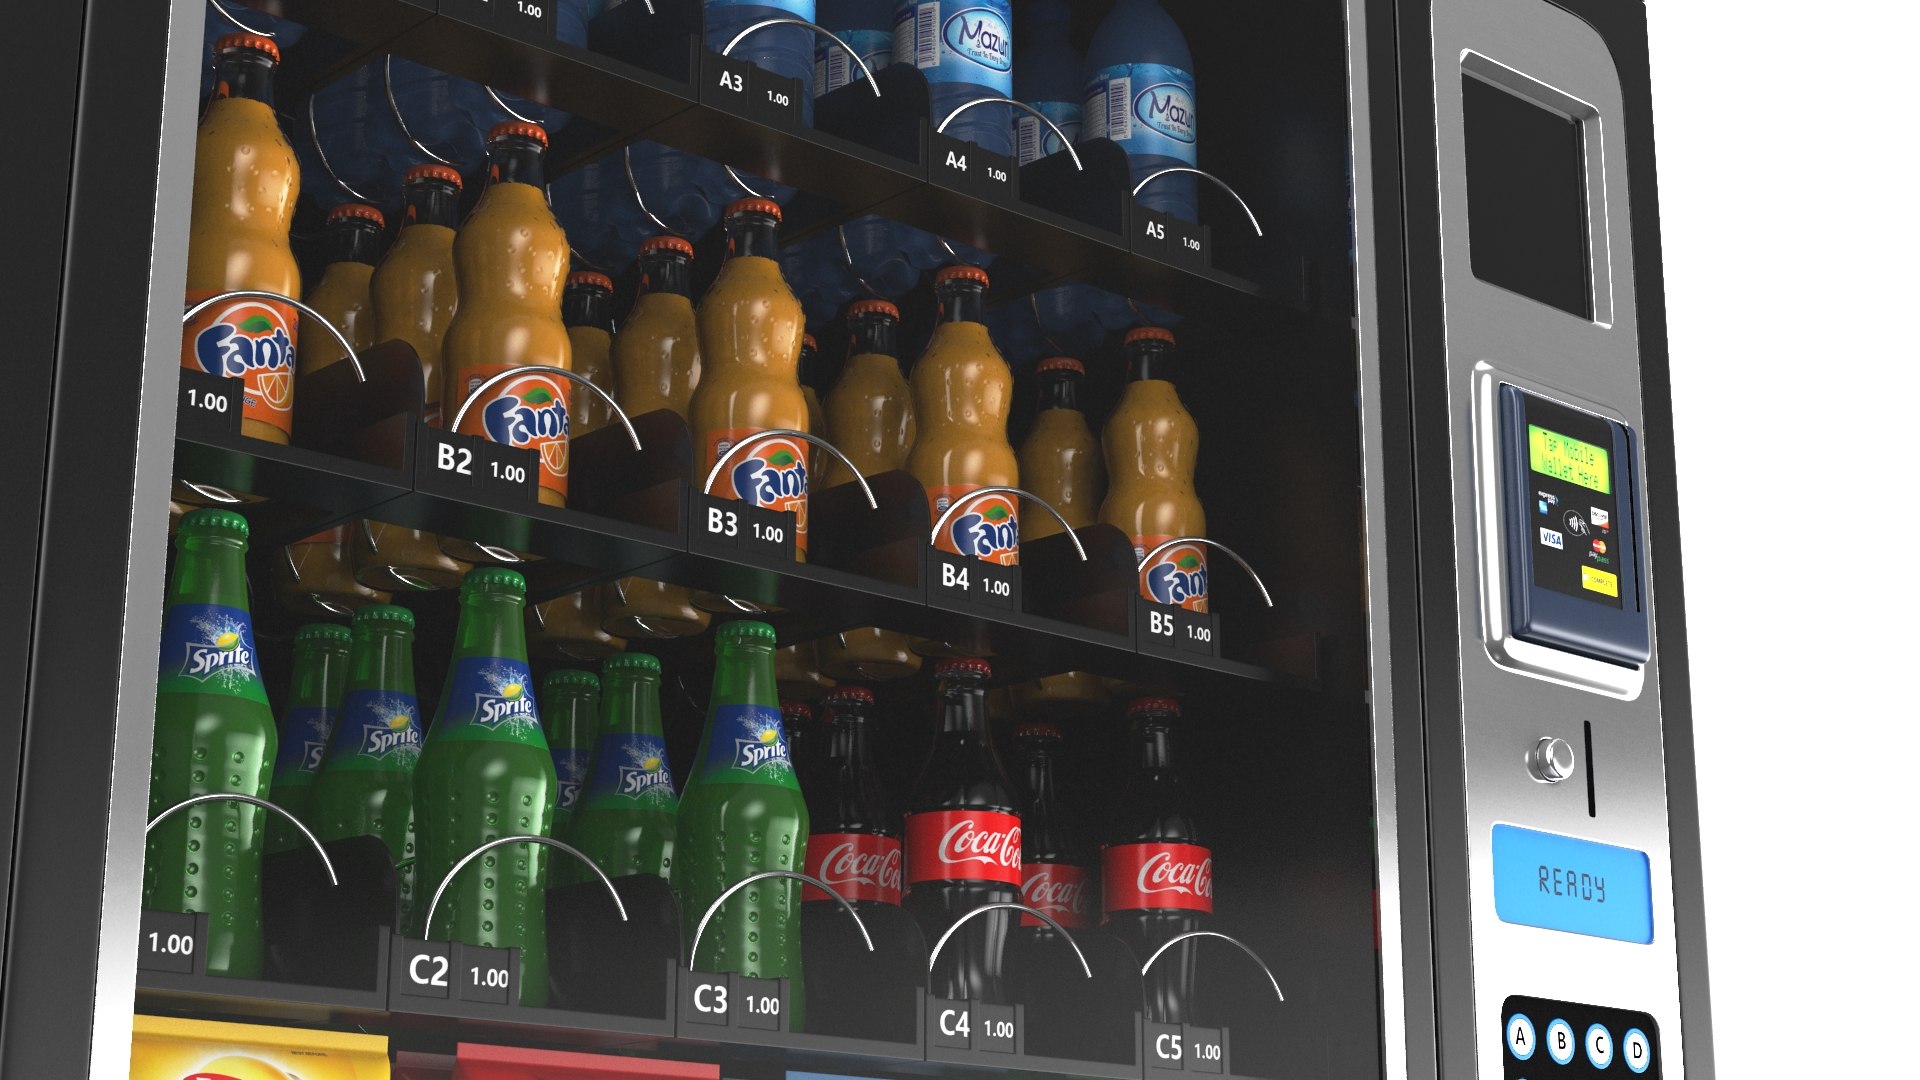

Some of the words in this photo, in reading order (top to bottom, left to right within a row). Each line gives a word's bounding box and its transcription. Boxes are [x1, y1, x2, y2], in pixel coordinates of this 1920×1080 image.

[518, 1, 541, 18] 1.00
[720, 71, 742, 91] A3
[768, 91, 788, 106] 1.00
[946, 151, 966, 171] A4
[988, 168, 1006, 182] 1.00
[1147, 221, 1164, 239] A5
[1183, 238, 1199, 250] 1.00
[195, 322, 295, 377] Fanta
[189, 390, 227, 412] 1.00
[438, 443, 472, 475] B2
[491, 462, 525, 483] 1.00
[1563, 440, 1595, 467] Mobile
[1577, 465, 1599, 489] Here
[709, 507, 737, 536] B3
[753, 524, 783, 542] 1.00
[951, 512, 1018, 556] Fant
[1543, 532, 1562, 545] VISA
[943, 563, 969, 590] B4
[984, 578, 1009, 596] 1.00
[1146, 562, 1207, 604] Fant
[1151, 611, 1173, 636] B5
[1188, 625, 1210, 641] 1.00
[188, 645, 251, 674] Sprite
[481, 695, 533, 723] Sprite
[368, 727, 418, 753] Sprite
[741, 741, 787, 767] Sprite
[624, 771, 669, 793] Sprite
[1539, 865, 1606, 903] READY
[150, 933, 193, 954] 1.00
[410, 955, 448, 986] C2
[471, 967, 508, 987] 1.00
[695, 984, 727, 1013] C3
[747, 996, 779, 1014] 1.00
[940, 1010, 969, 1037] C4
[985, 1021, 1013, 1038] 1.00
[1516, 1027, 1526, 1046] A
[1156, 1034, 1181, 1059] C5
[1195, 1044, 1220, 1060] 1.00
[1557, 1032, 1567, 1050] B
[1595, 1036, 1605, 1054] C
[1633, 1042, 1643, 1059] D
